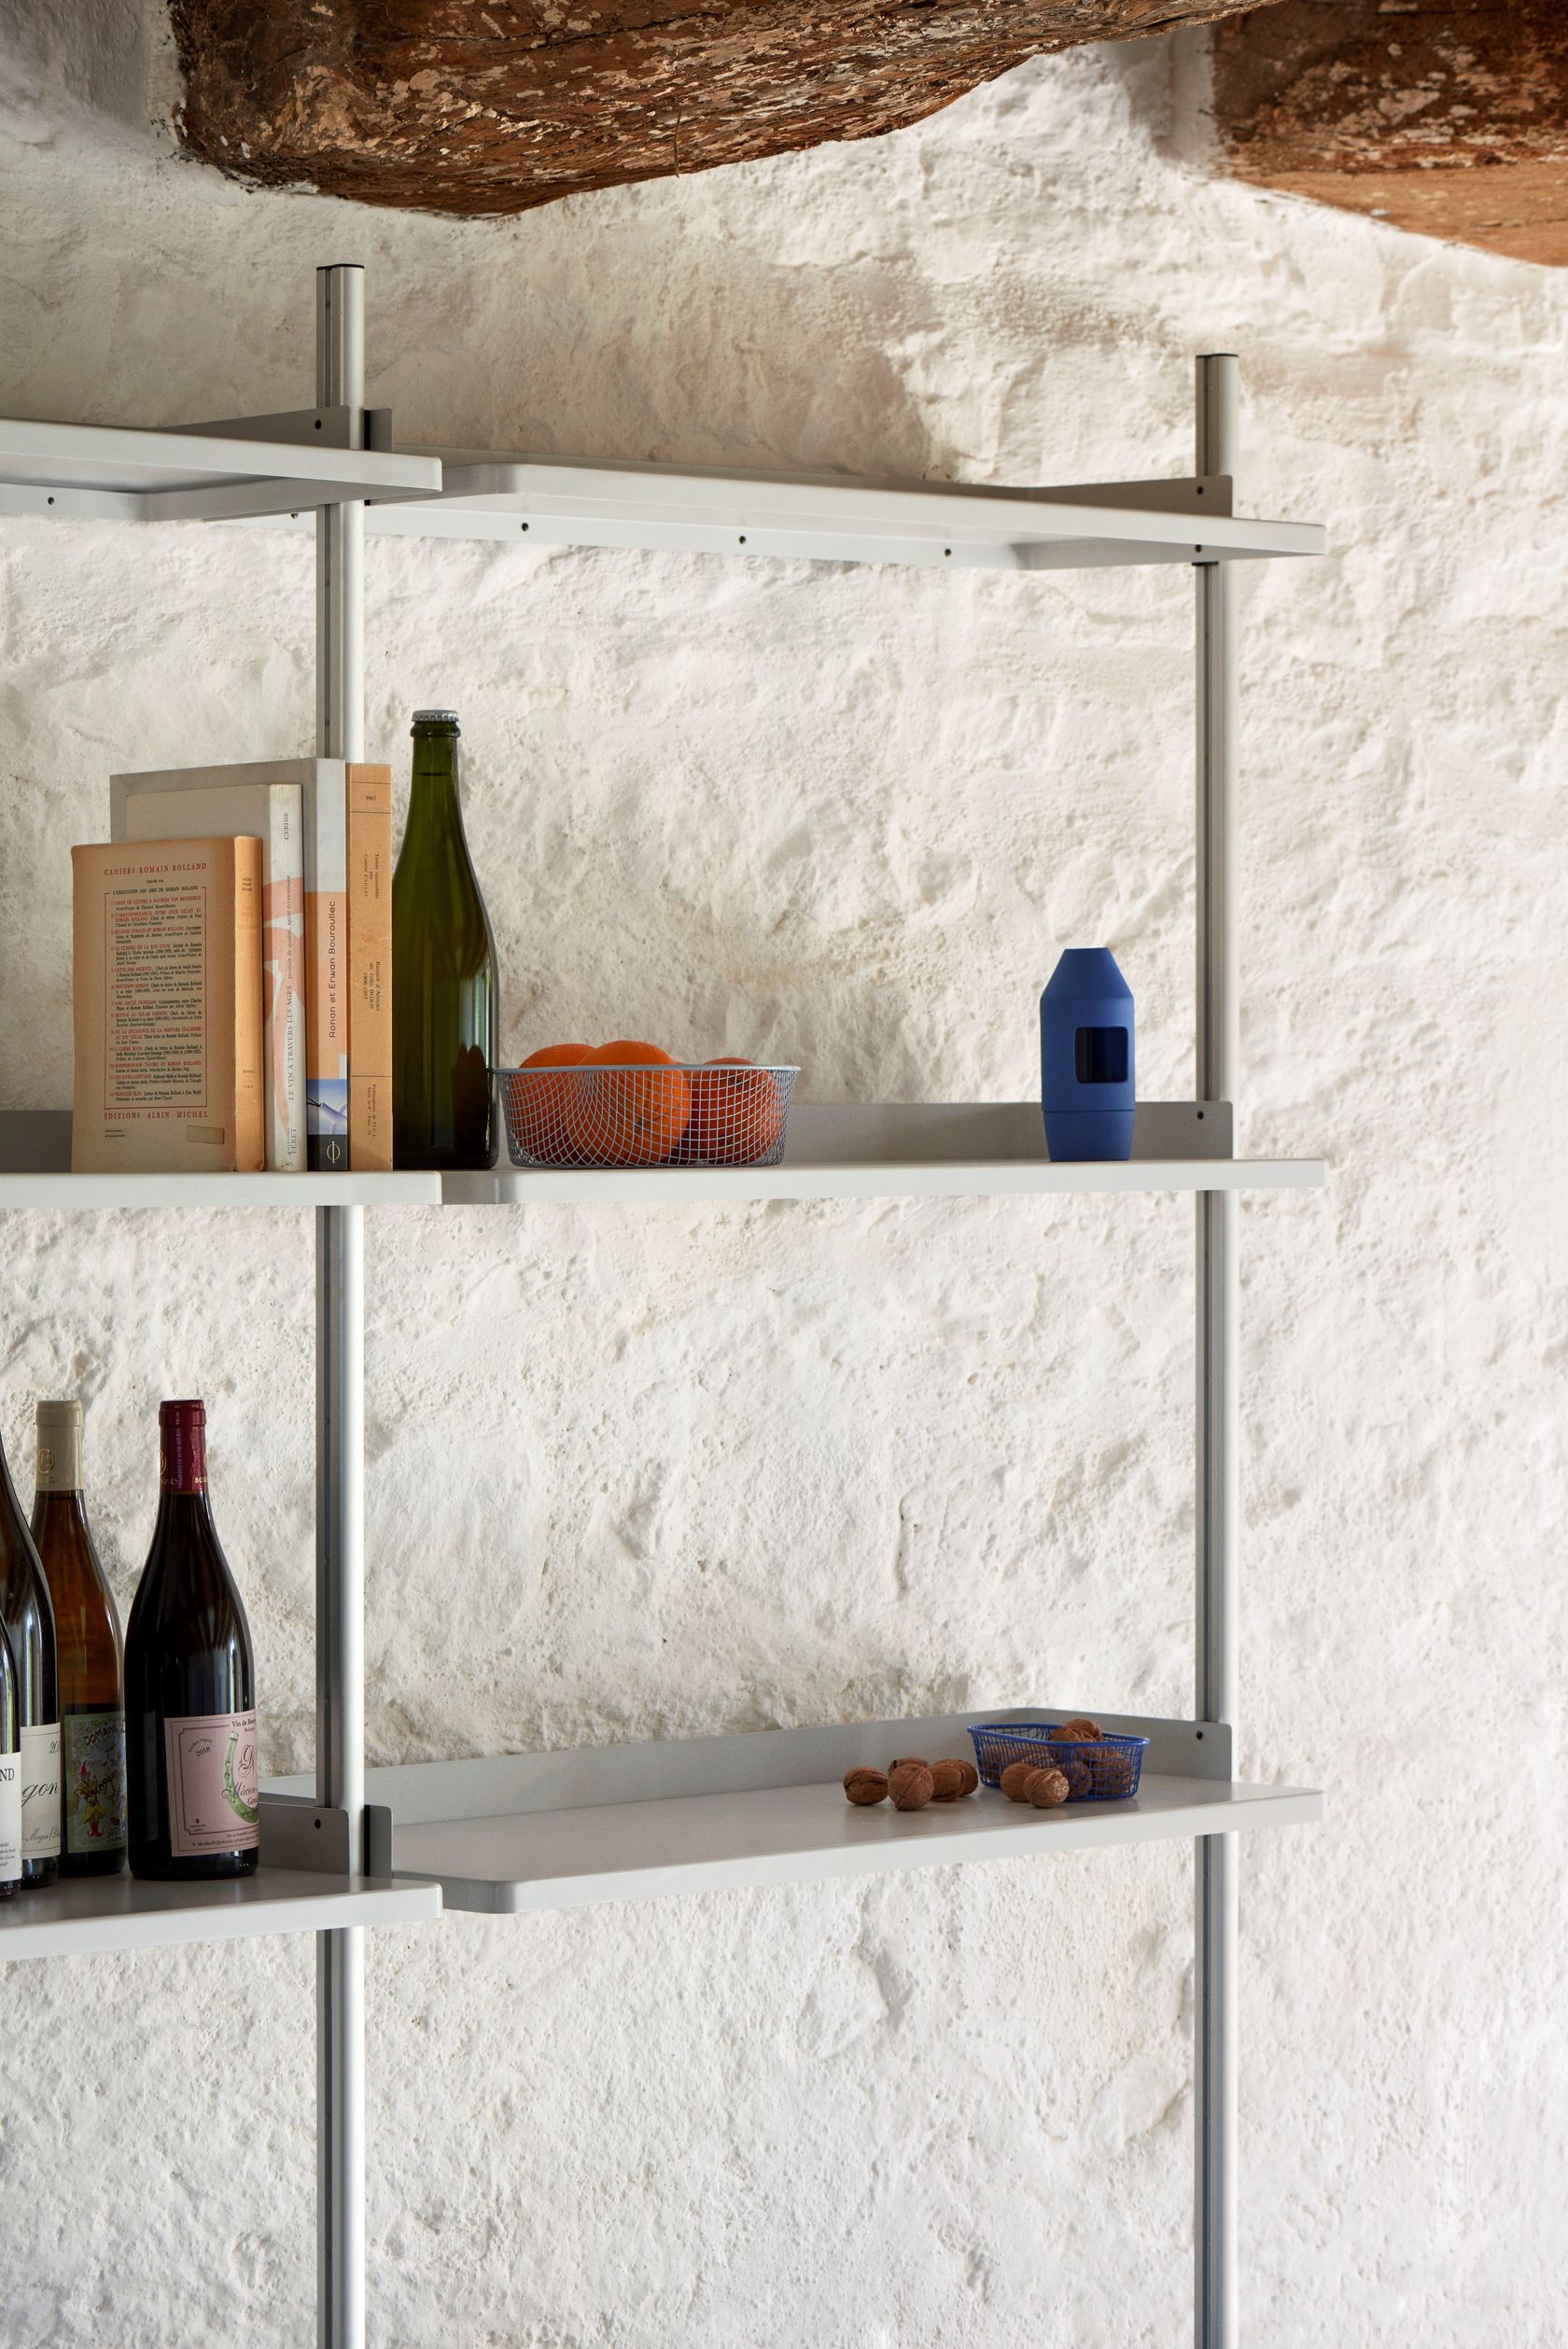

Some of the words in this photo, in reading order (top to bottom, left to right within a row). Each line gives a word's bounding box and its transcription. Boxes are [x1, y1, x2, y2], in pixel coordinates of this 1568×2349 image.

[172, 863, 207, 871] ROLLAND
[329, 993, 336, 1003] et
[288, 1090, 294, 1100] LE
[84, 1723, 119, 1747] DOMAINE
[196, 1746, 210, 1757] 2018
